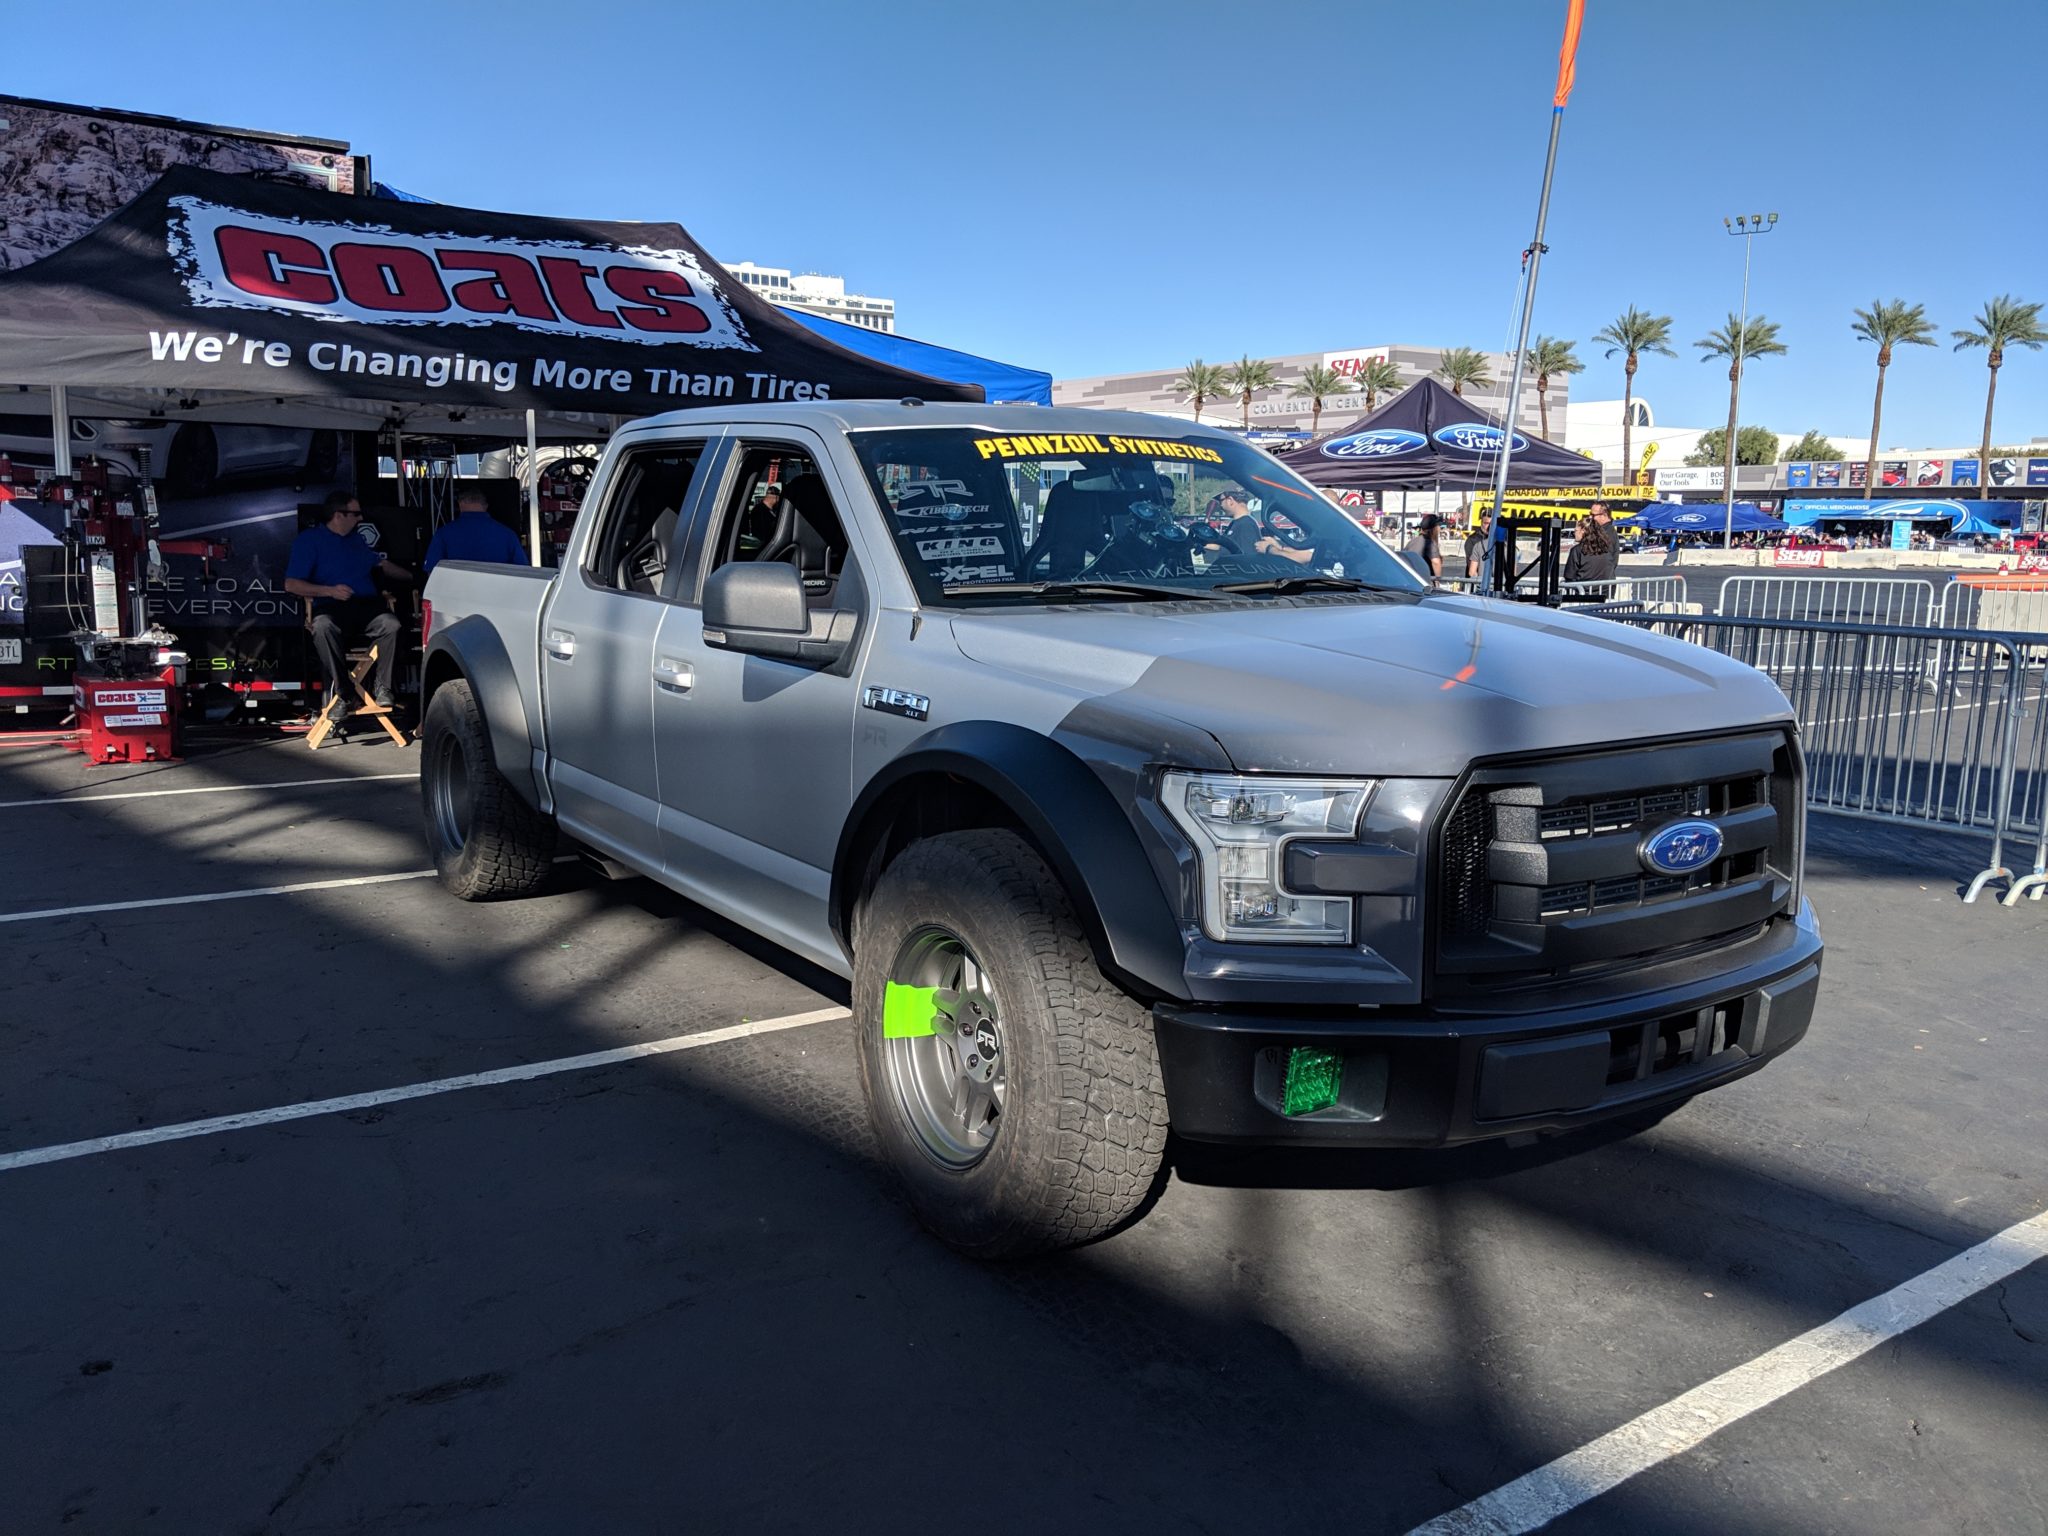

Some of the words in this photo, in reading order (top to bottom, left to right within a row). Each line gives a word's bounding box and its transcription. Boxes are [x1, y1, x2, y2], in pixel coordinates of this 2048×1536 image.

[307, 342, 518, 392] Changing
[532, 358, 632, 392] More
[644, 368, 734, 398] Than
[745, 372, 831, 402] Tires
[1253, 399, 1329, 415] CONVENTIN
[1336, 396, 1384, 409] CENTR
[1337, 434, 1410, 455] Ford
[1453, 428, 1505, 448] Ford
[973, 434, 1110, 460] PENNZOIL
[1107, 436, 1224, 464] SYNTHETICS
[1503, 488, 1550, 497] AGNAFLOW
[1572, 487, 1633, 497] MAGNAFLOW
[899, 522, 1006, 536] NITTO
[921, 538, 997, 551] KING
[1776, 549, 1822, 562] SEMA
[941, 564, 1014, 583] XPEL
[962, 577, 1001, 586] PROTECTION
[147, 600, 298, 615] EVERYON
[905, 710, 919, 718] XLT
